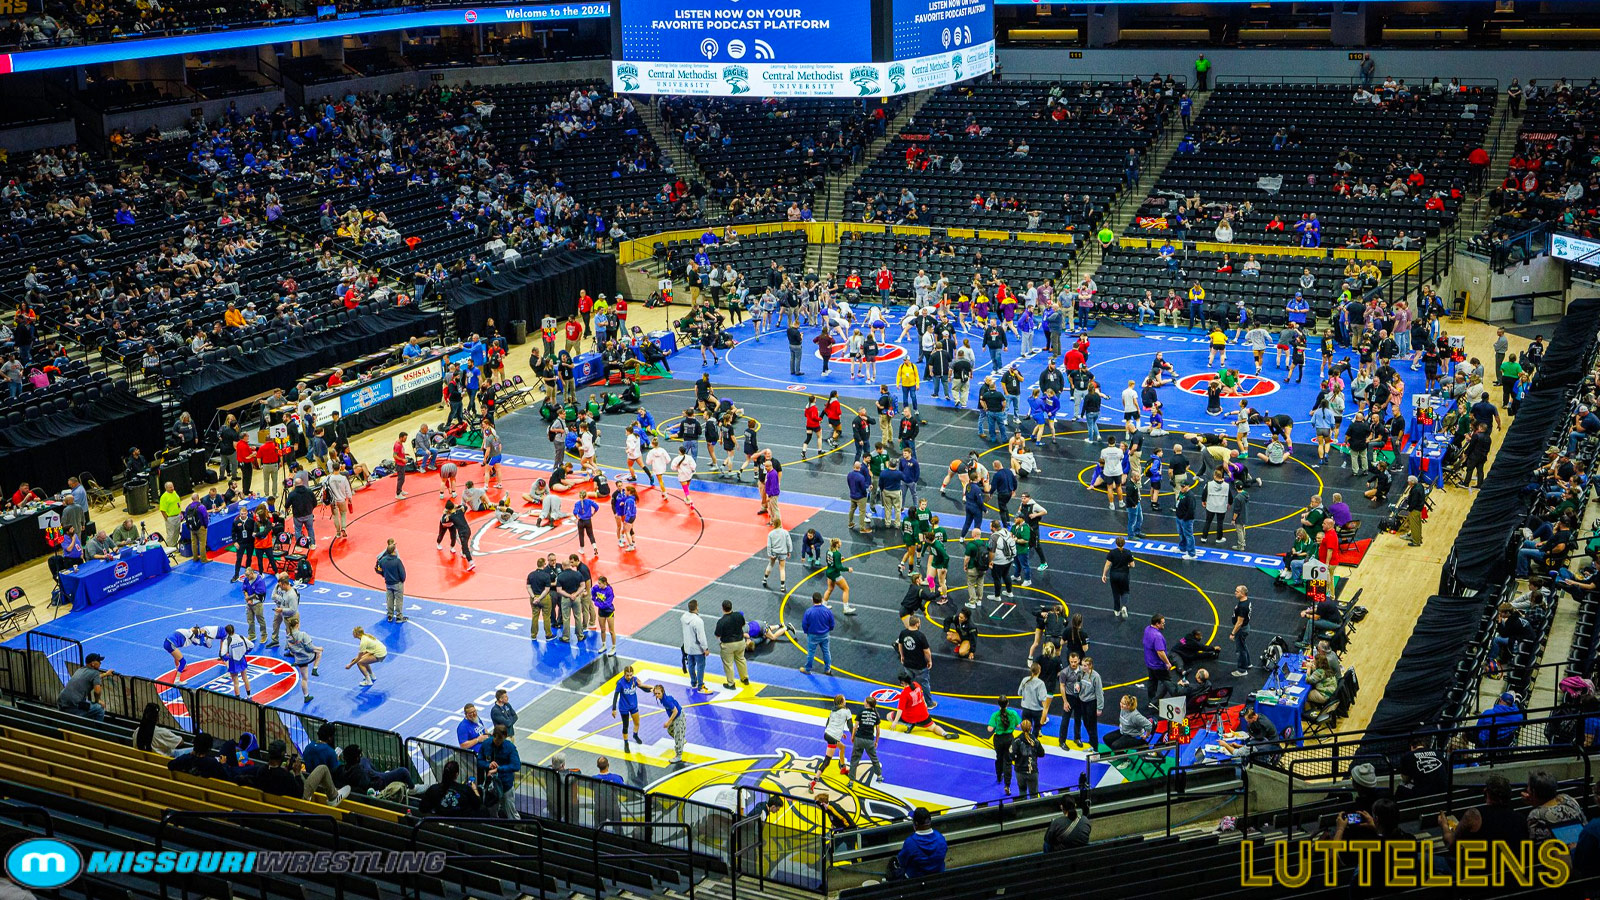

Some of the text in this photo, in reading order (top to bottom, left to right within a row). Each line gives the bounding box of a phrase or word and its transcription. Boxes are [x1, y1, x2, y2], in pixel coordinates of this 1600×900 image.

[928, 1, 948, 11] LISTEN
[506, 7, 548, 19] Welcome
[550, 7, 561, 17] to
[562, 6, 579, 16] the
[581, 5, 605, 15] 2024
[675, 9, 802, 19] LISTEN NOW ON YOUR
[914, 12, 945, 24] FAVORITE
[945, 8, 967, 19] PODCAST
[652, 19, 830, 30] FAVORITE PODCAST PLATFORM
[617, 65, 639, 76] EAGLES
[648, 69, 718, 80] Central Methodist
[723, 67, 749, 79] EAGLES
[911, 64, 929, 75] Central
[762, 71, 844, 81] Central Methodist
[850, 70, 880, 81] EAGLES
[1451, 337, 1457, 347] 2
[403, 366, 431, 382] MSHSAA
[1416, 396, 1421, 407] 4
[275, 427, 281, 438] 5
[45, 516, 52, 528] 7
[1310, 566, 1319, 580] 6
[291, 583, 525, 631] MSHSA.ORG
[1166, 704, 1174, 720] 8
